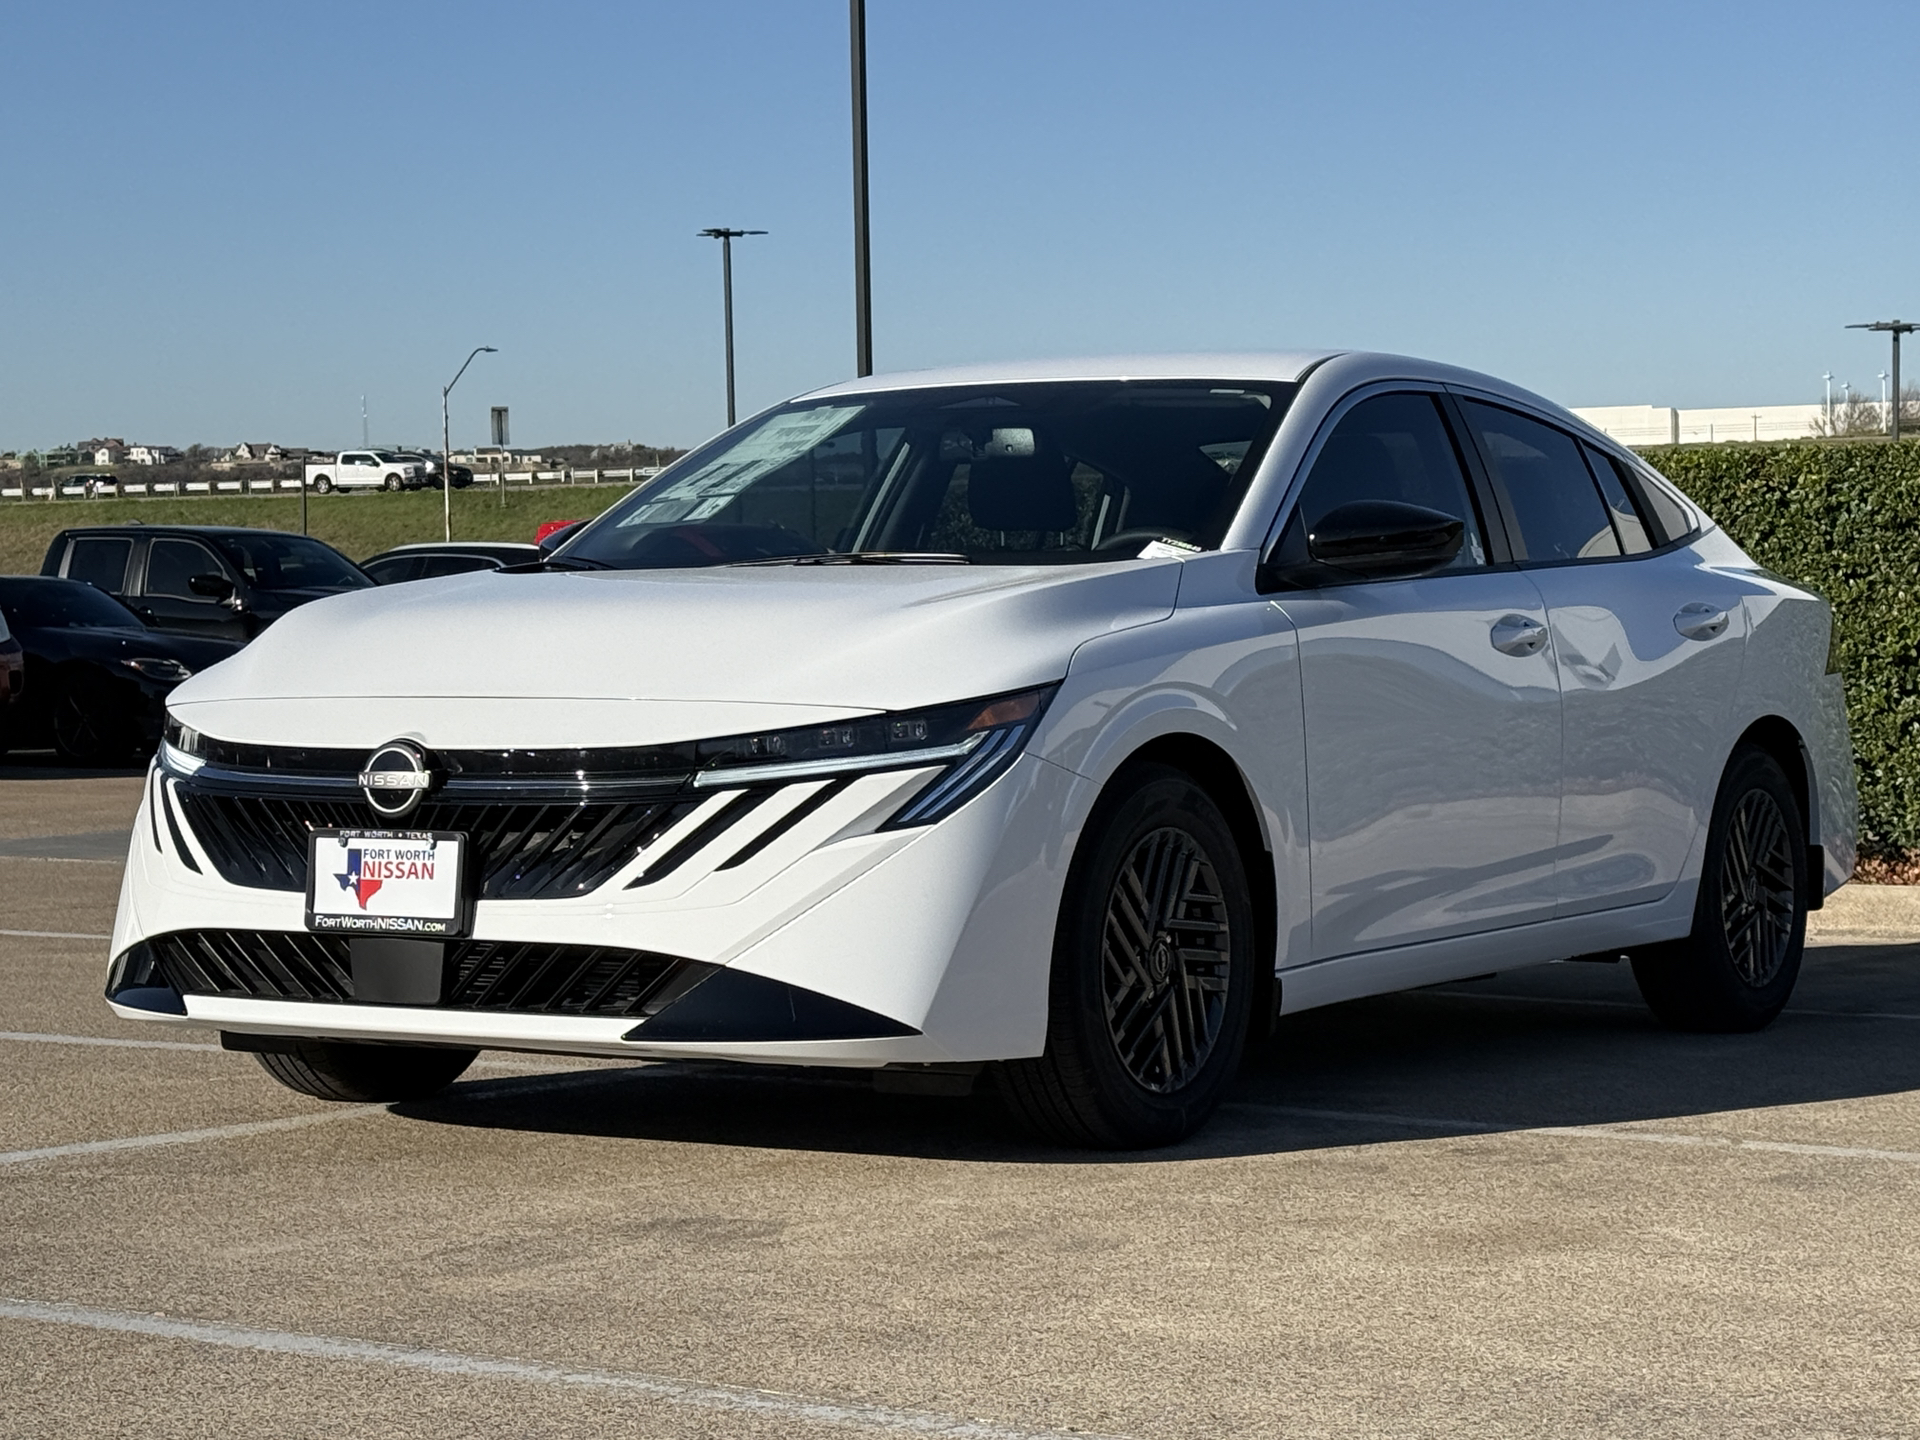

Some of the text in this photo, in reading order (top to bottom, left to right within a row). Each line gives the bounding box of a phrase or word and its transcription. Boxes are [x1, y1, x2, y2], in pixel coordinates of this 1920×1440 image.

[358, 773, 429, 787] NISSAN
[339, 830, 361, 838] FORT
[364, 830, 393, 838] WORTH
[363, 849, 435, 861] FORT WORTH
[363, 861, 434, 880] NISSAN
